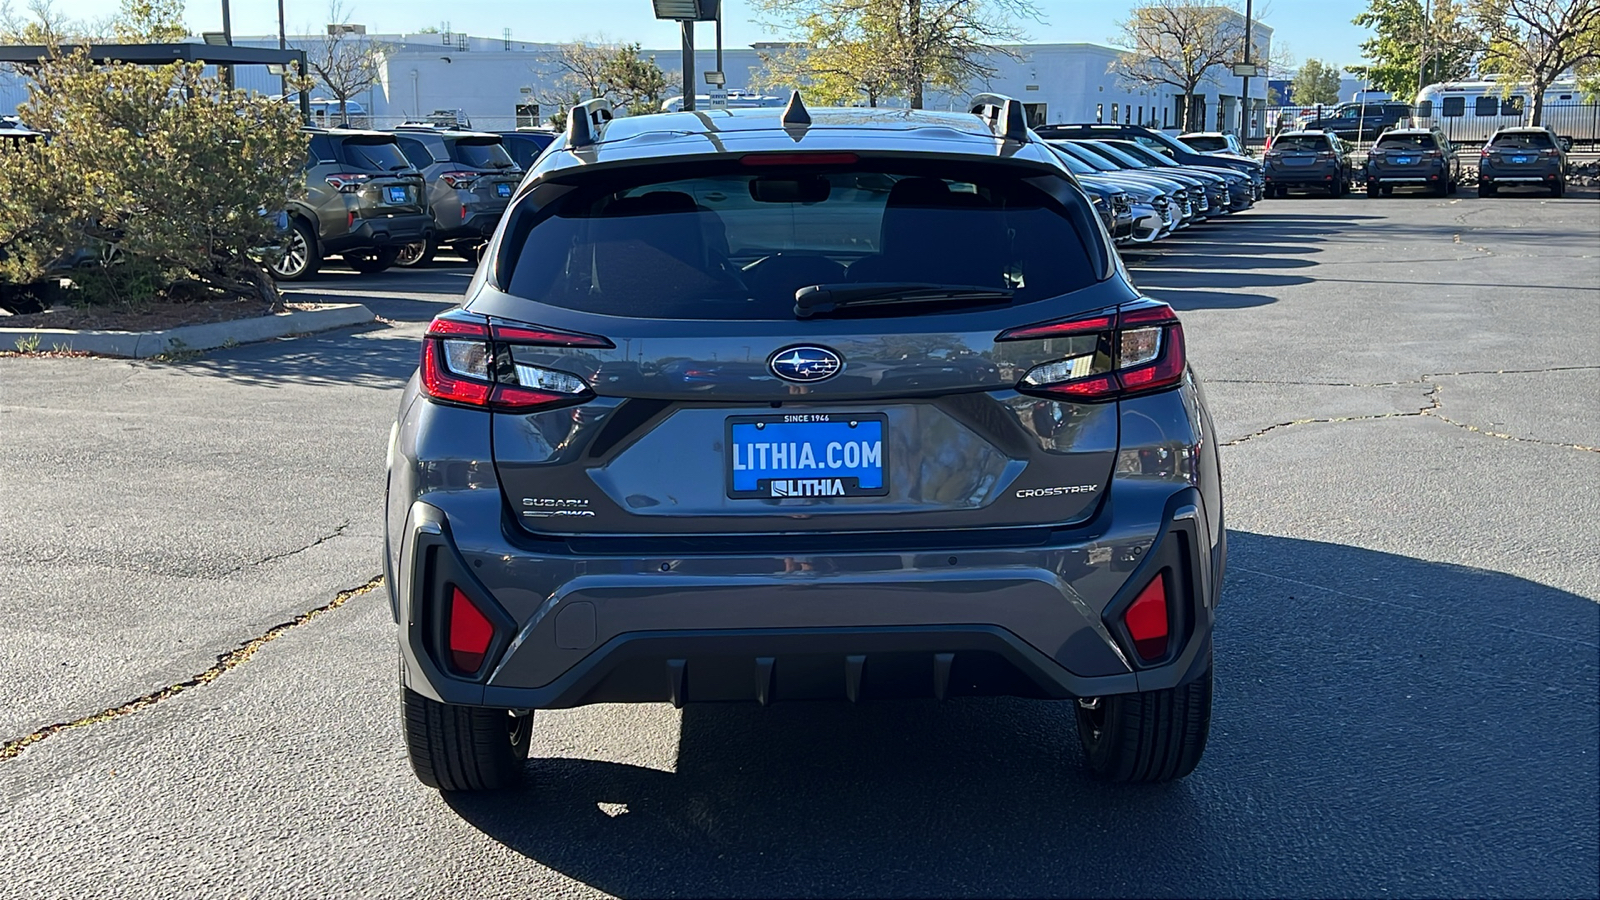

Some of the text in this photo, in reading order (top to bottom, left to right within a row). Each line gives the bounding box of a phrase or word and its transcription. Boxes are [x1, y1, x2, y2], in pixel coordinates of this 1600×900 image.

[811, 414, 830, 422] 1946
[733, 441, 882, 470] LITHIA.COM
[788, 479, 845, 496] LITHIA
[1016, 484, 1098, 498] CROSSTREK
[522, 497, 589, 507] SUBARU
